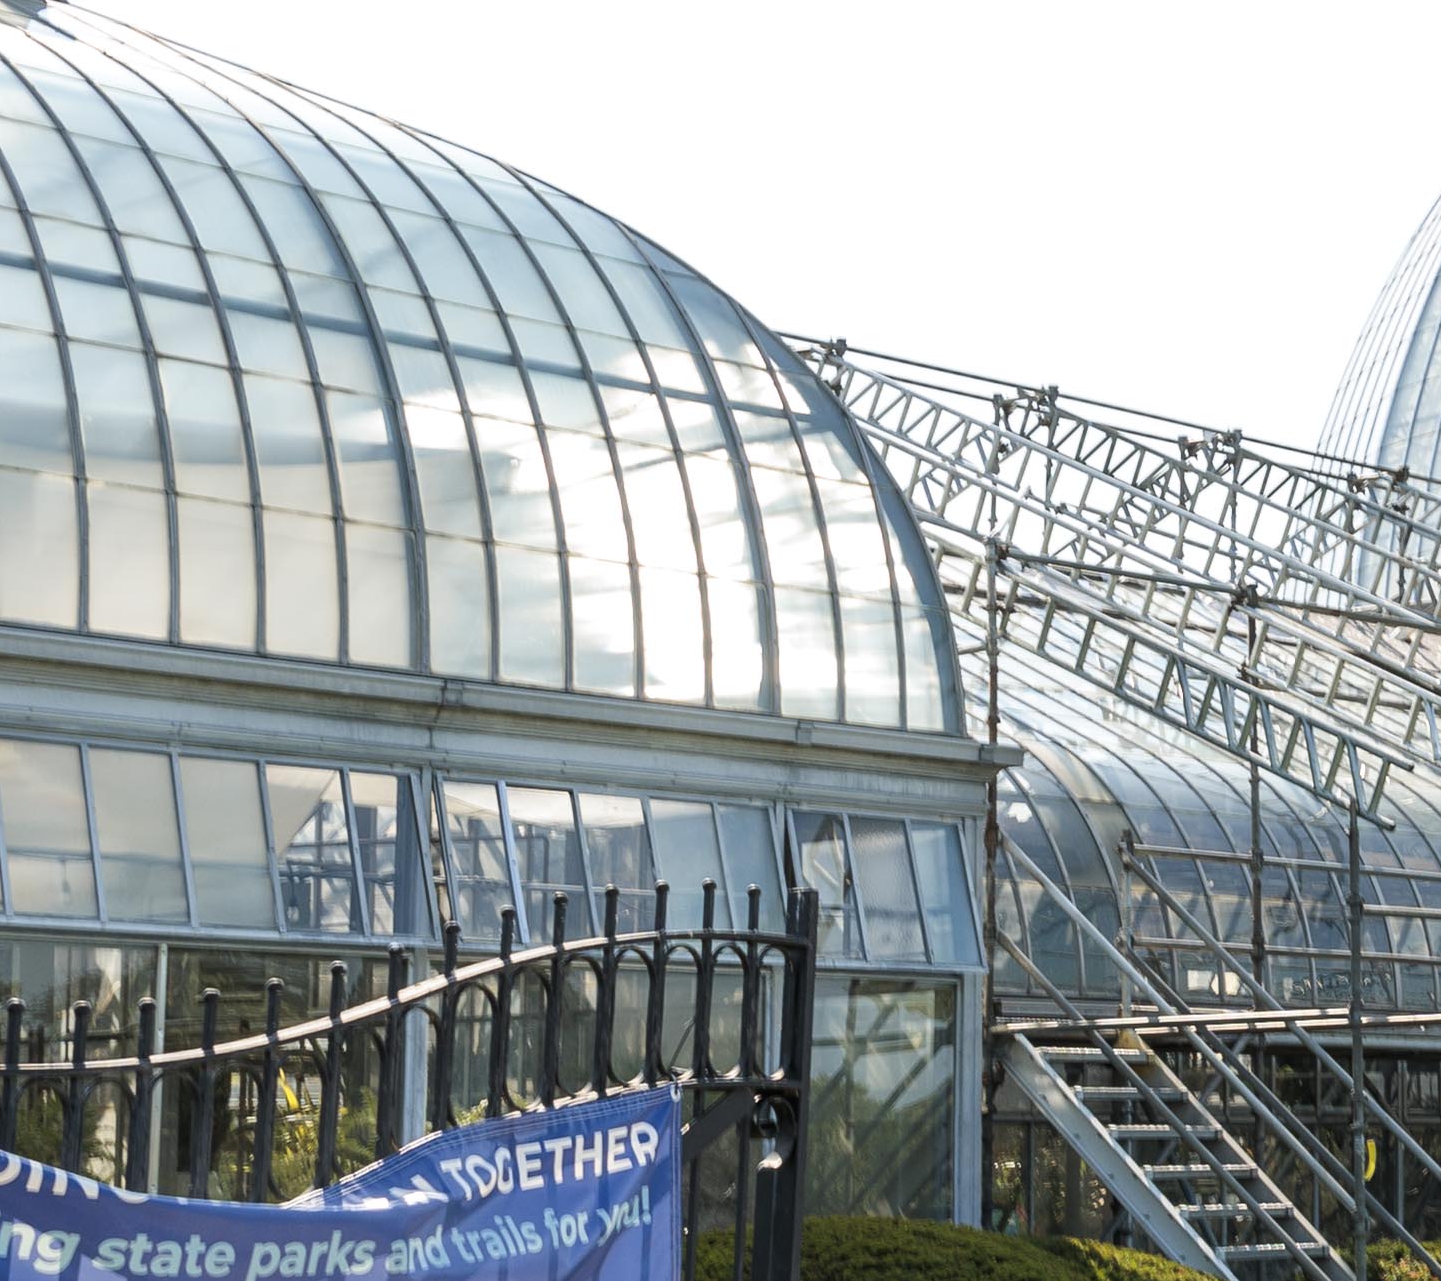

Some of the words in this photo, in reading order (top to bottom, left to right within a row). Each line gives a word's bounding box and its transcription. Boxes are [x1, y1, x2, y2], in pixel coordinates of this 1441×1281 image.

[440, 1121, 659, 1201] TOGETHER
[91, 1232, 236, 1279] state
[384, 1225, 452, 1272] and
[450, 1214, 544, 1266] trails
[544, 1207, 590, 1249] for
